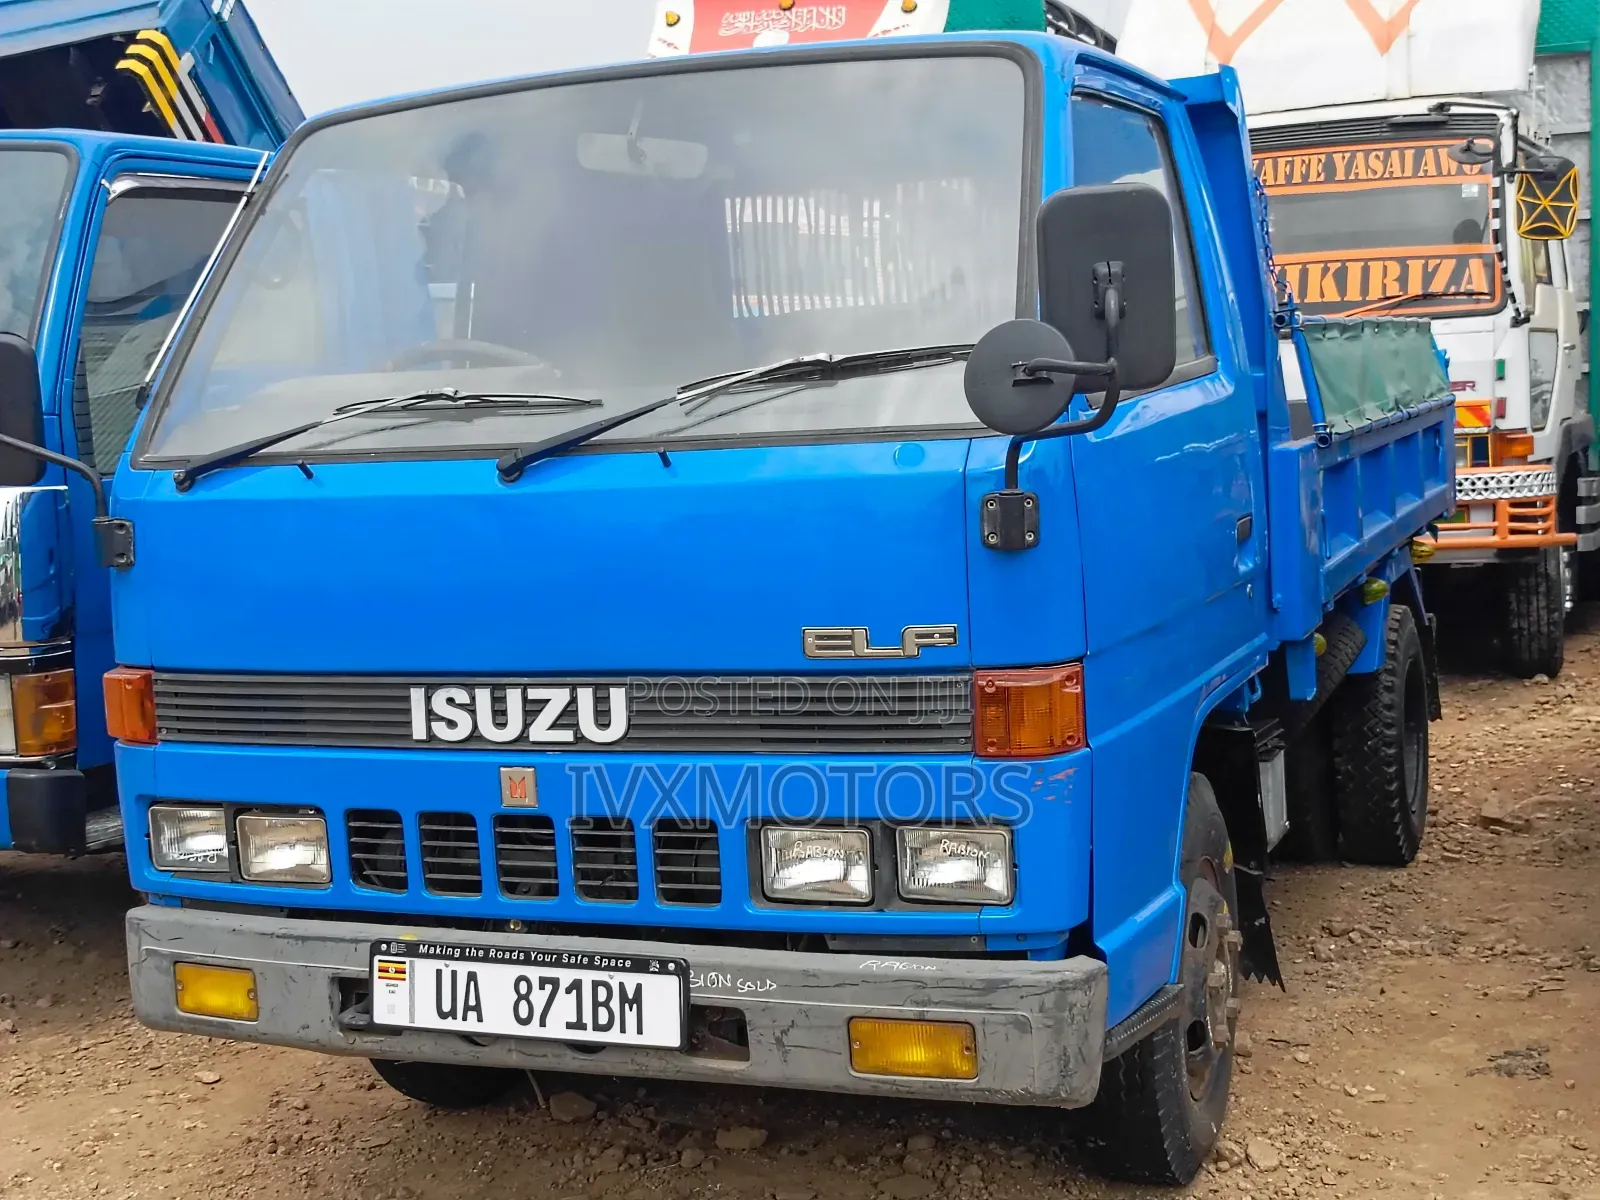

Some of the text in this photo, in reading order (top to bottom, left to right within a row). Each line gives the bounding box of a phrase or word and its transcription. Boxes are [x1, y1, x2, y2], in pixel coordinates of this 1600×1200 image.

[802, 624, 958, 659] ELF
[409, 685, 630, 744] ISUZU
[939, 838, 991, 859] RABION
[418, 944, 461, 958] Making
[465, 947, 485, 957] the
[489, 948, 525, 960] Roads
[530, 951, 557, 962] Your
[562, 953, 589, 964] Safe
[594, 955, 632, 968] Space
[736, 978, 777, 992] SOLD
[435, 968, 643, 1035] UA 871BM
